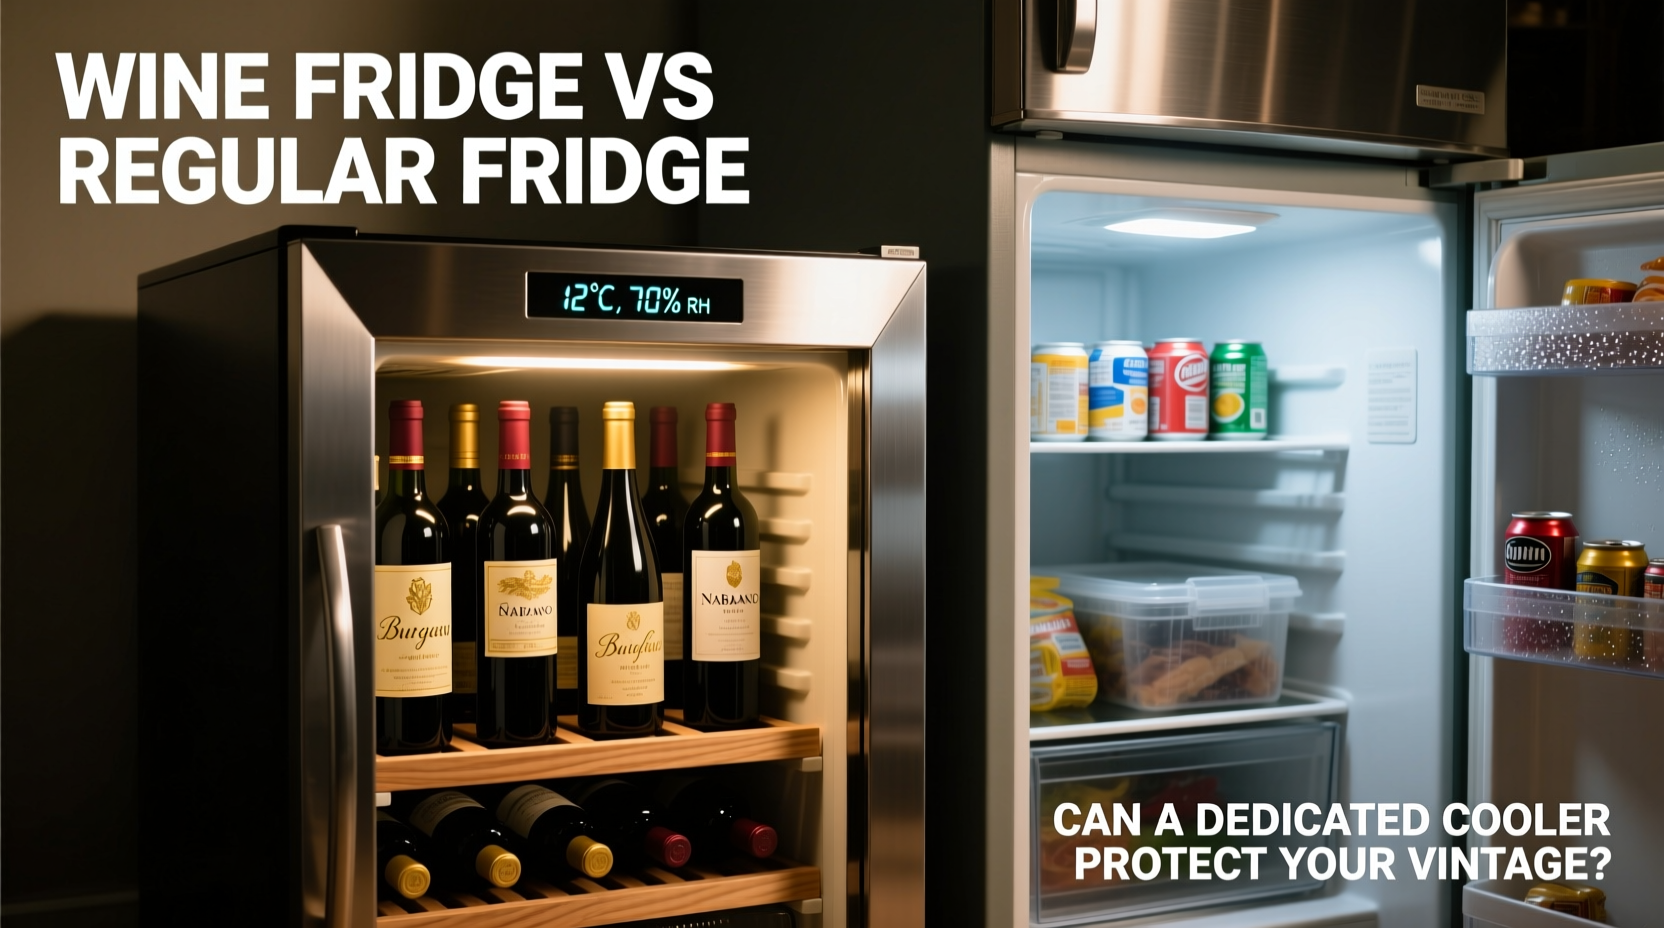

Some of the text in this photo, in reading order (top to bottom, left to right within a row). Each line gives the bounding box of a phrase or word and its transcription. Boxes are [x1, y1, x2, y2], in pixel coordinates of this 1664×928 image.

[563, 282, 710, 314] 12°C, 70% RH
